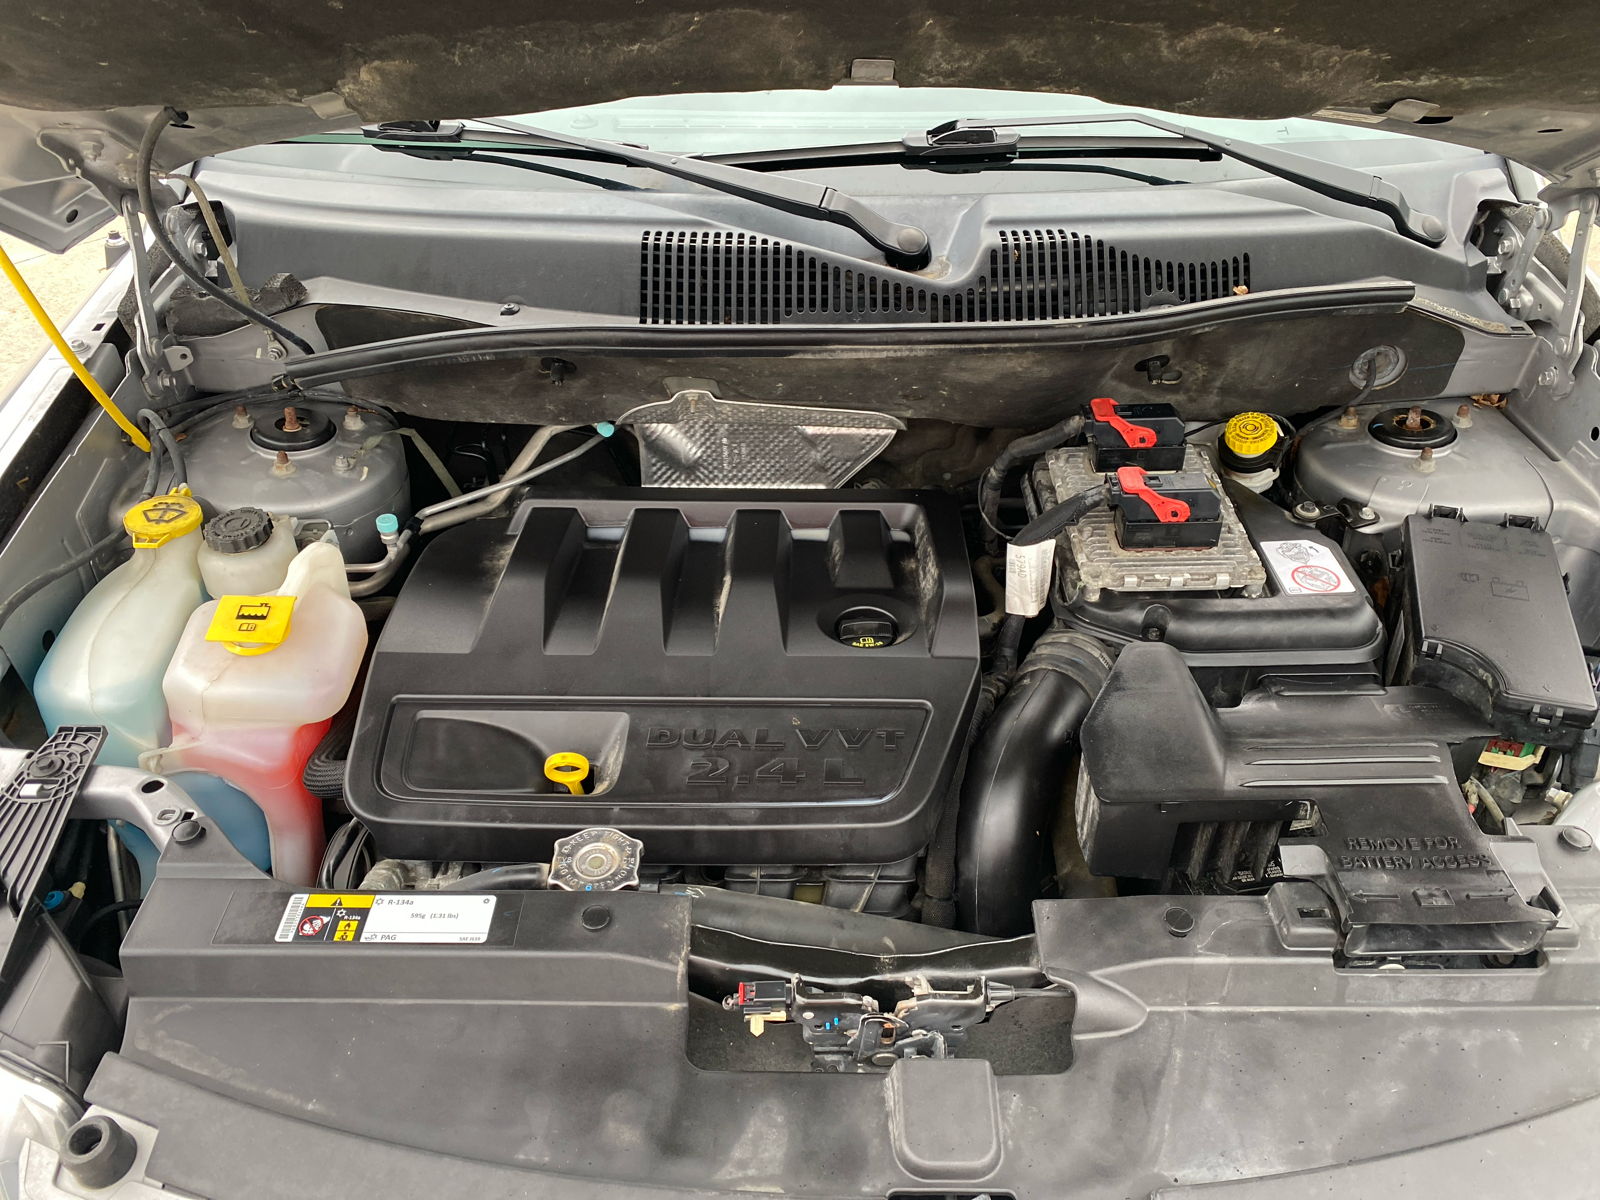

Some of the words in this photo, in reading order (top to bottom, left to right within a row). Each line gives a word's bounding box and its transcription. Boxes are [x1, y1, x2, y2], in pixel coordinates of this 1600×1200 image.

[1016, 554, 1027, 579] 579AD
[646, 728, 786, 748] DUAL
[795, 728, 905, 749] VVT
[686, 757, 807, 787] 2.4
[823, 758, 865, 787] L
[570, 831, 598, 846] KEEP
[604, 830, 631, 846] TIGHT
[1346, 837, 1421, 851] REMOVE
[1424, 836, 1462, 850] FOR
[1340, 855, 1414, 870] BATTERY
[1420, 854, 1493, 870] ACCESS
[410, 912, 427, 920] 595g
[446, 912, 459, 920] lbs)
